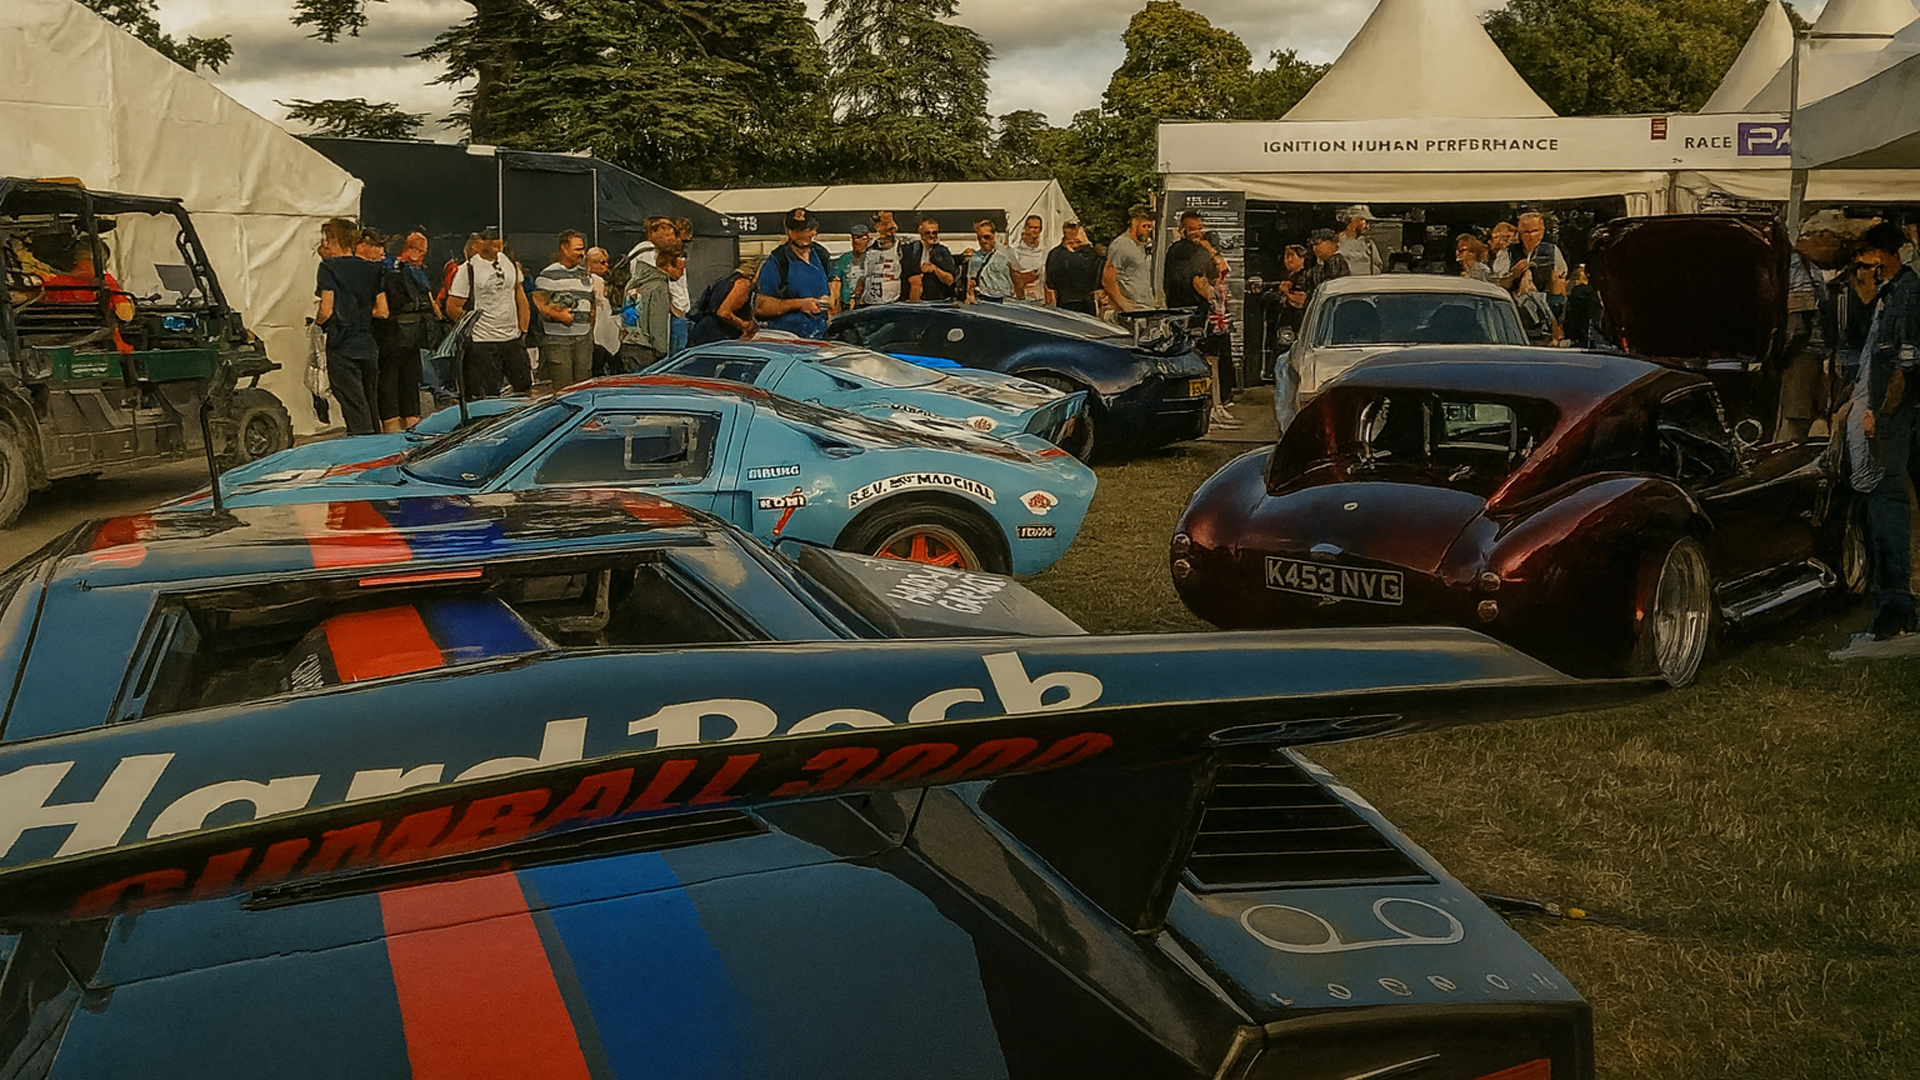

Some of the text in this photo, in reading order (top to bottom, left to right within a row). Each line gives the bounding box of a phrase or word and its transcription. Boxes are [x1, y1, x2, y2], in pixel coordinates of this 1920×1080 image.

[1263, 140, 1347, 153] IGNITION
[1684, 136, 1732, 149] RACE
[1267, 559, 1401, 600] K453 NVG
